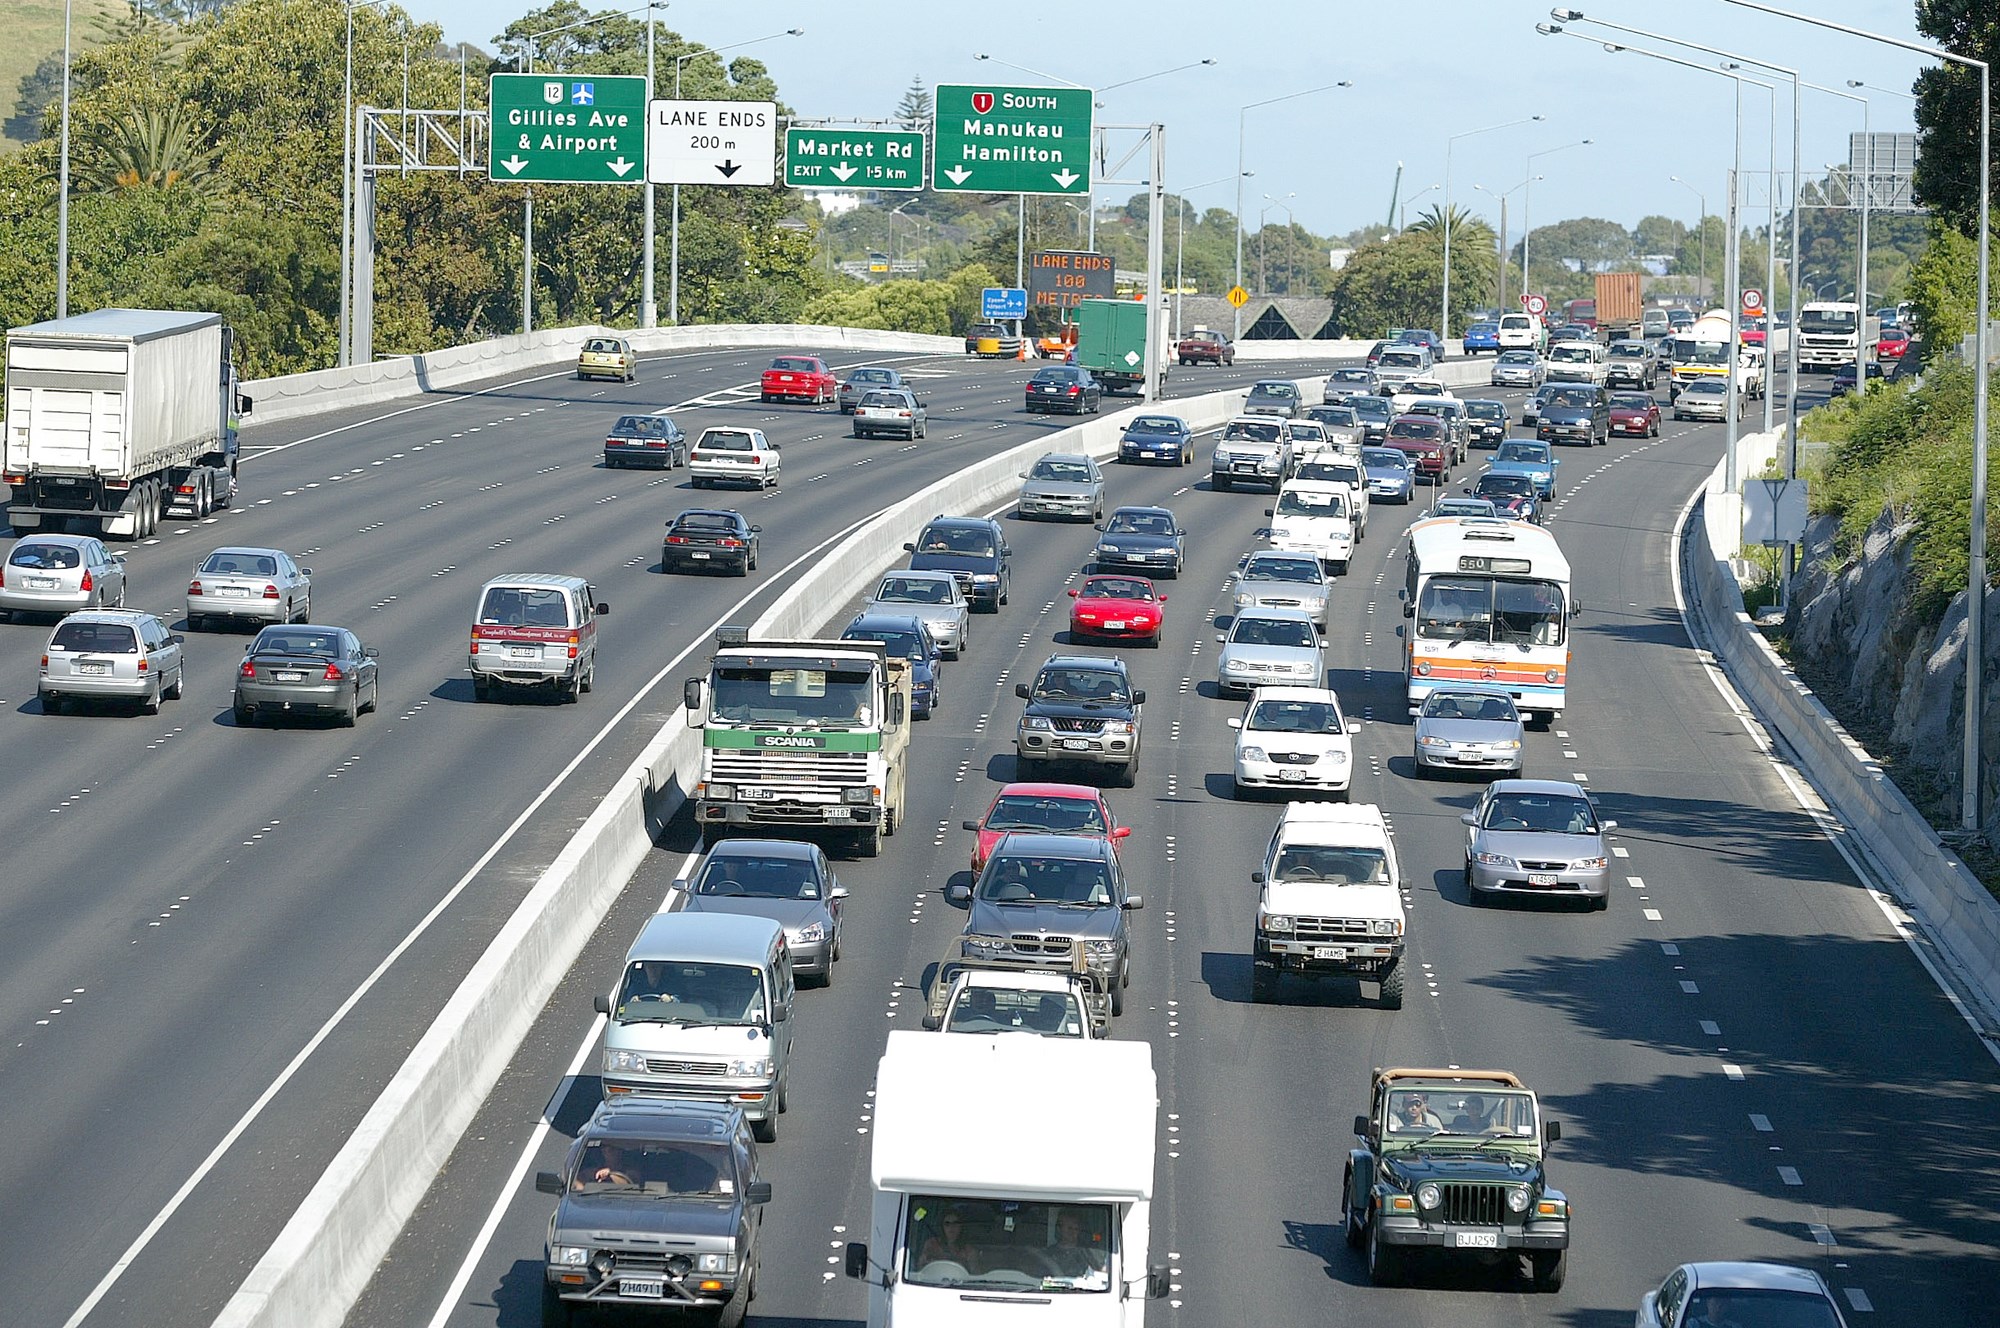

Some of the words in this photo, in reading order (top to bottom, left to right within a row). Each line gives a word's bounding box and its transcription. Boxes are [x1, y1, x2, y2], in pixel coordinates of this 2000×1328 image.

[547, 86, 560, 99] 12
[980, 95, 987, 109] 1
[508, 109, 577, 127] Gillies
[588, 110, 629, 127] Ave
[660, 110, 708, 126] LANE
[718, 111, 766, 128] ENDS
[963, 119, 1064, 138] Manukau
[518, 133, 531, 150] &
[540, 133, 618, 154] Airport
[690, 135, 720, 149] 200
[724, 141, 736, 149] m
[798, 139, 874, 157] Market
[886, 141, 912, 158] Rd
[962, 143, 1063, 163] Hamilton
[793, 165, 823, 177] EXIT
[886, 168, 907, 179] km
[1032, 254, 1069, 269] LANE
[1074, 256, 1111, 271] ENDS
[1055, 273, 1086, 288] 100
[1035, 290, 1105, 306] METR
[1530, 301, 1542, 309] 80
[1746, 295, 1758, 303] 80
[1460, 558, 1485, 569] 550
[765, 736, 816, 747] SCANIA
[1316, 949, 1322, 958] 2
[1457, 1234, 1496, 1246] BJJ259
[620, 1282, 660, 1294] ZH4911
